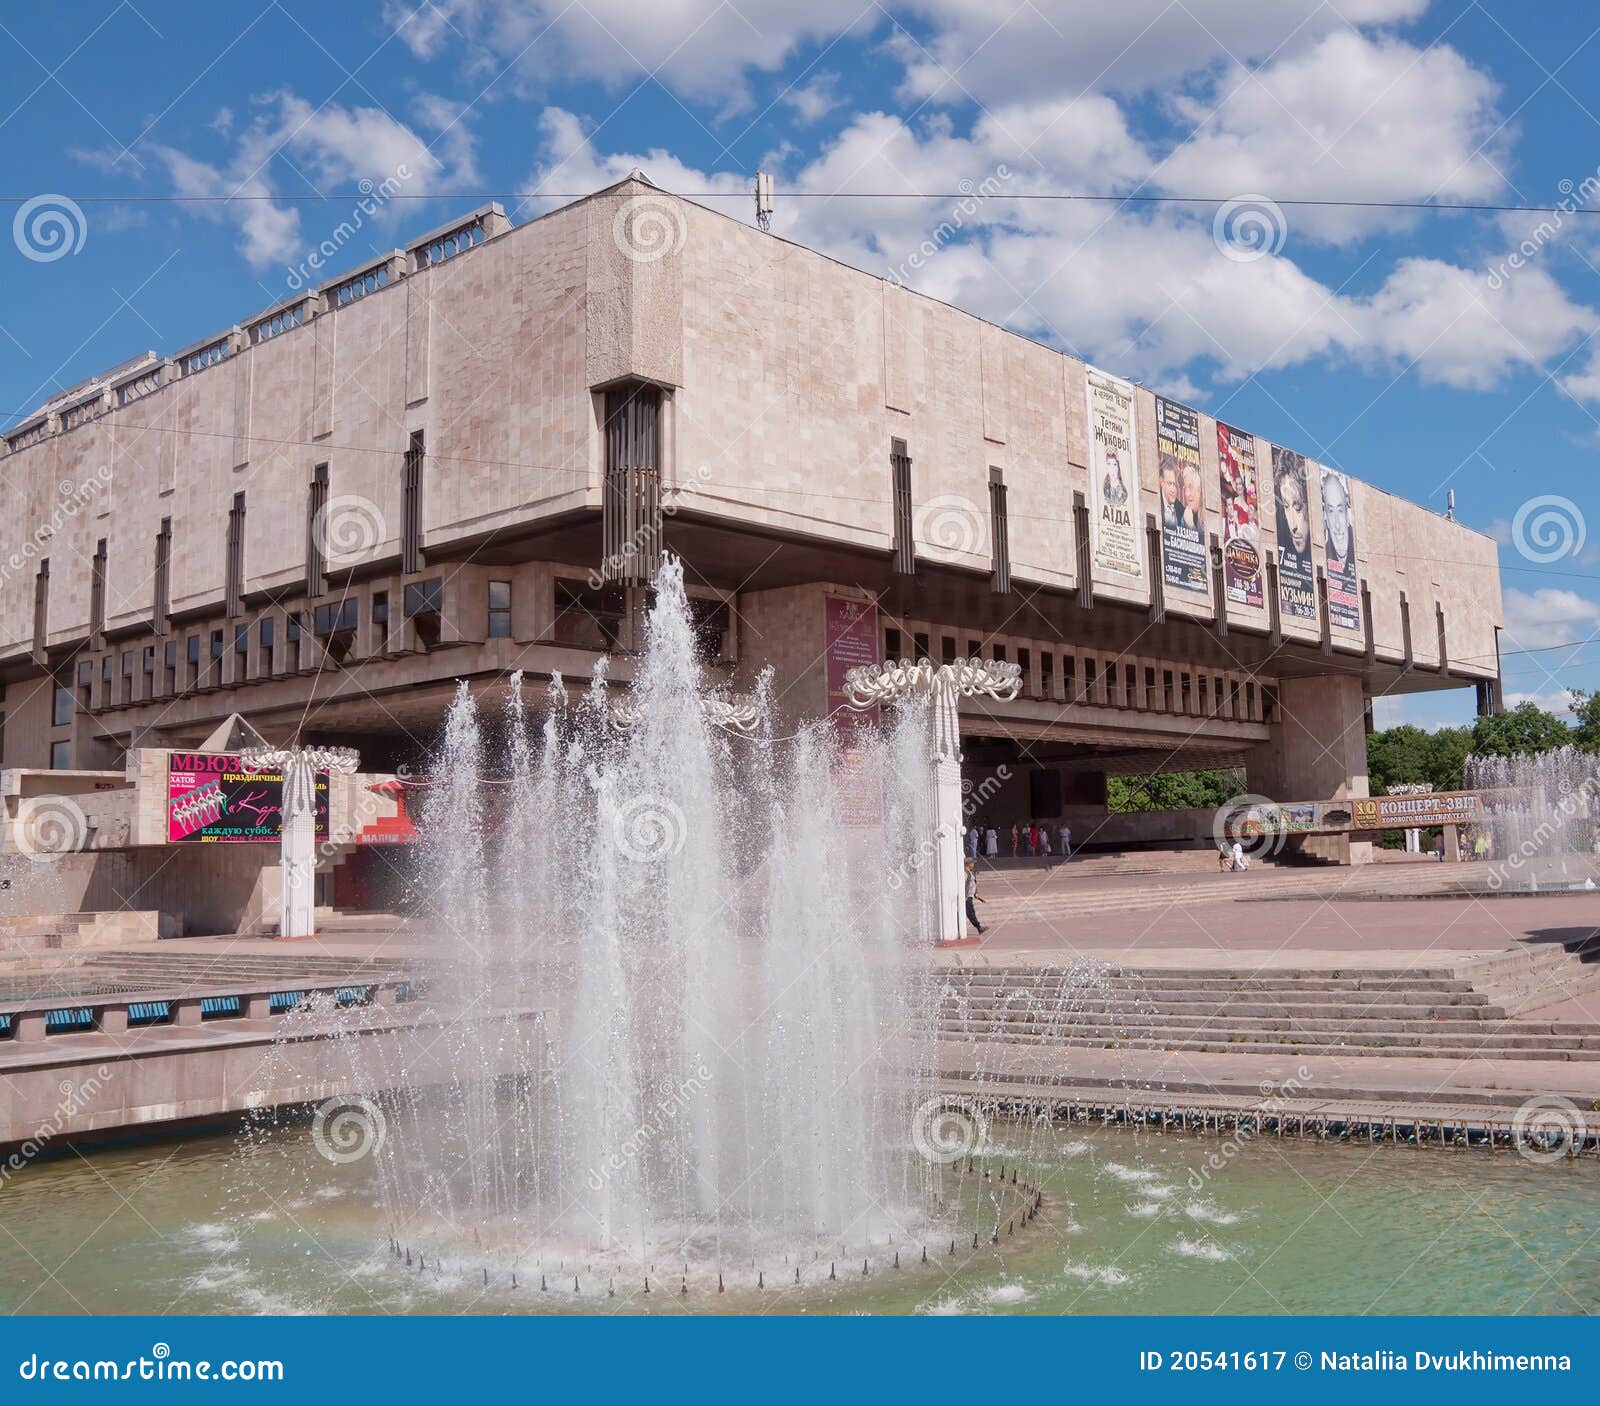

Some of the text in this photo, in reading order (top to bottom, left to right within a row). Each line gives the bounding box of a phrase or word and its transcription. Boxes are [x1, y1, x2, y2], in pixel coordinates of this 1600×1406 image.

[1278, 546, 1286, 565] 7
[1280, 586, 1315, 607] КУЗЬМИН
[1380, 796, 1477, 815] КОНЦЕРТ-ЗВІТ
[201, 827, 242, 838] каждую
